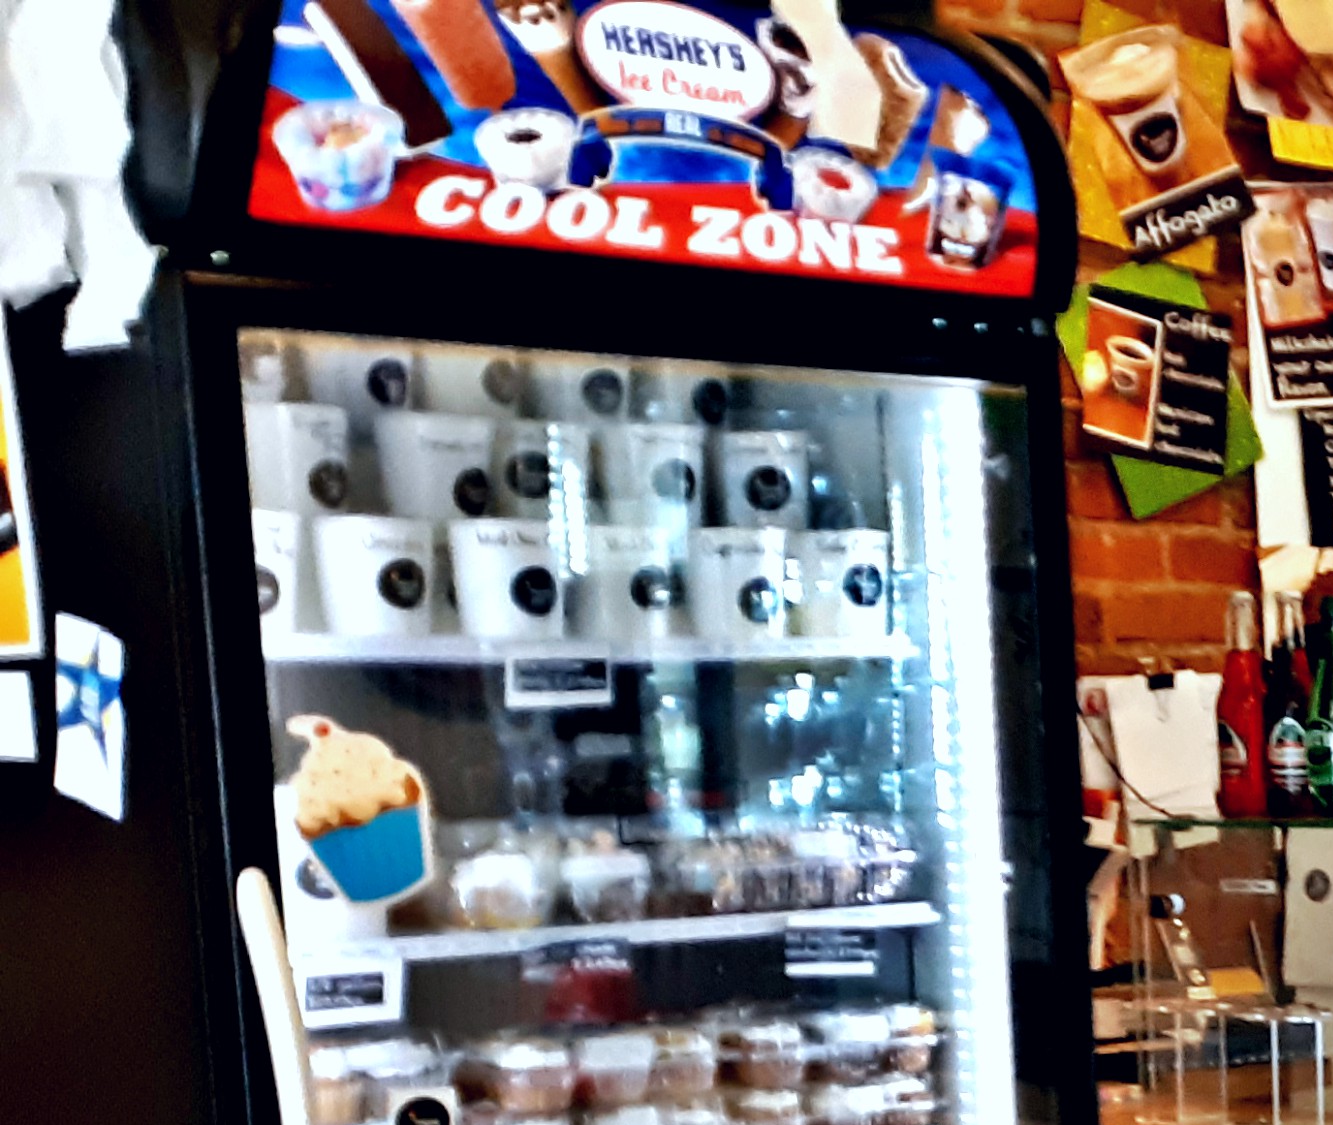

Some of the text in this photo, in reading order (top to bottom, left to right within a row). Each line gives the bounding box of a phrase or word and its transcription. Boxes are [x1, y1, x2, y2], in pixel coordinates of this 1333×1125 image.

[602, 22, 746, 73] HERSHEY'S
[619, 60, 747, 106] Ice Cream
[415, 174, 902, 275] COOL ZONE
[1135, 193, 1239, 249] Affogato
